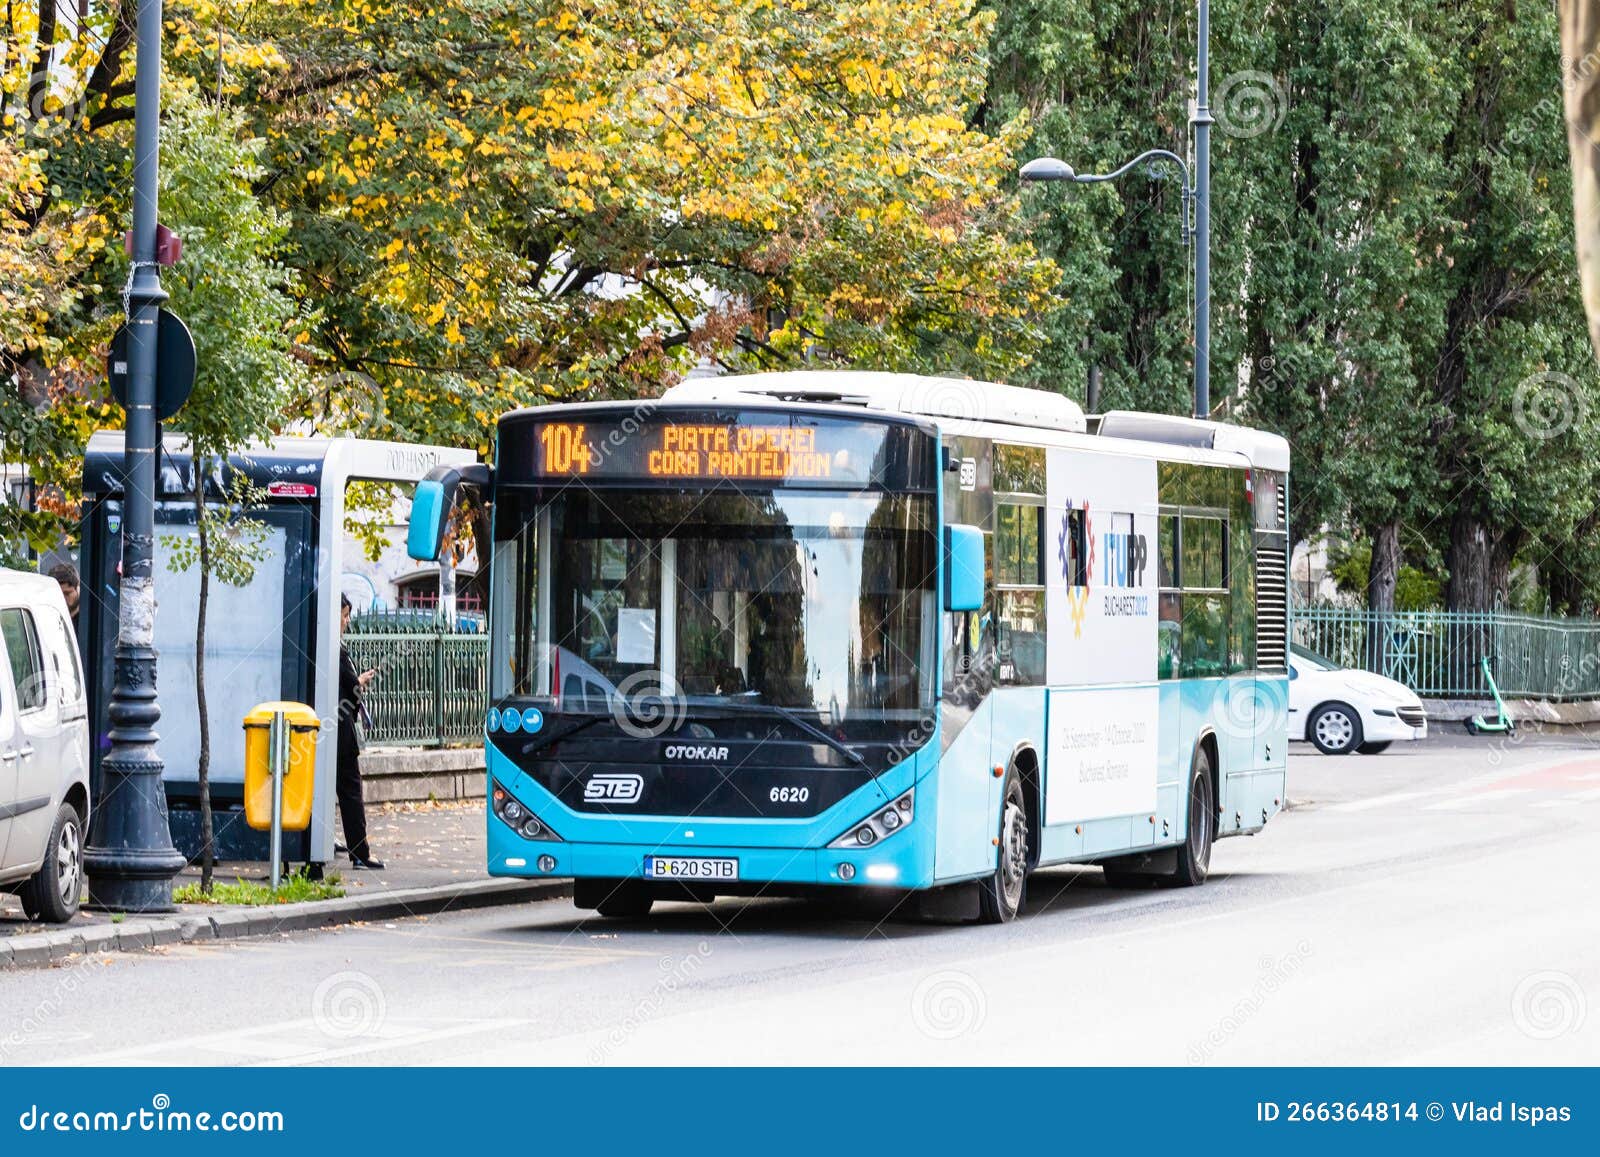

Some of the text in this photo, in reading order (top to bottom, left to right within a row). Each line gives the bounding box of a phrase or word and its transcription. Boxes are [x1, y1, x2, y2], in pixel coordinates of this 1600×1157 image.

[541, 423, 590, 473] 104
[664, 425, 815, 451] PIATA OPEREI
[648, 450, 832, 477] CORA PANTELIMON
[665, 746, 729, 760] OTOKAR
[584, 773, 644, 803] STB
[769, 787, 809, 802] 6620
[655, 860, 667, 875] B
[670, 861, 698, 876] 620
[701, 862, 734, 877] STB
